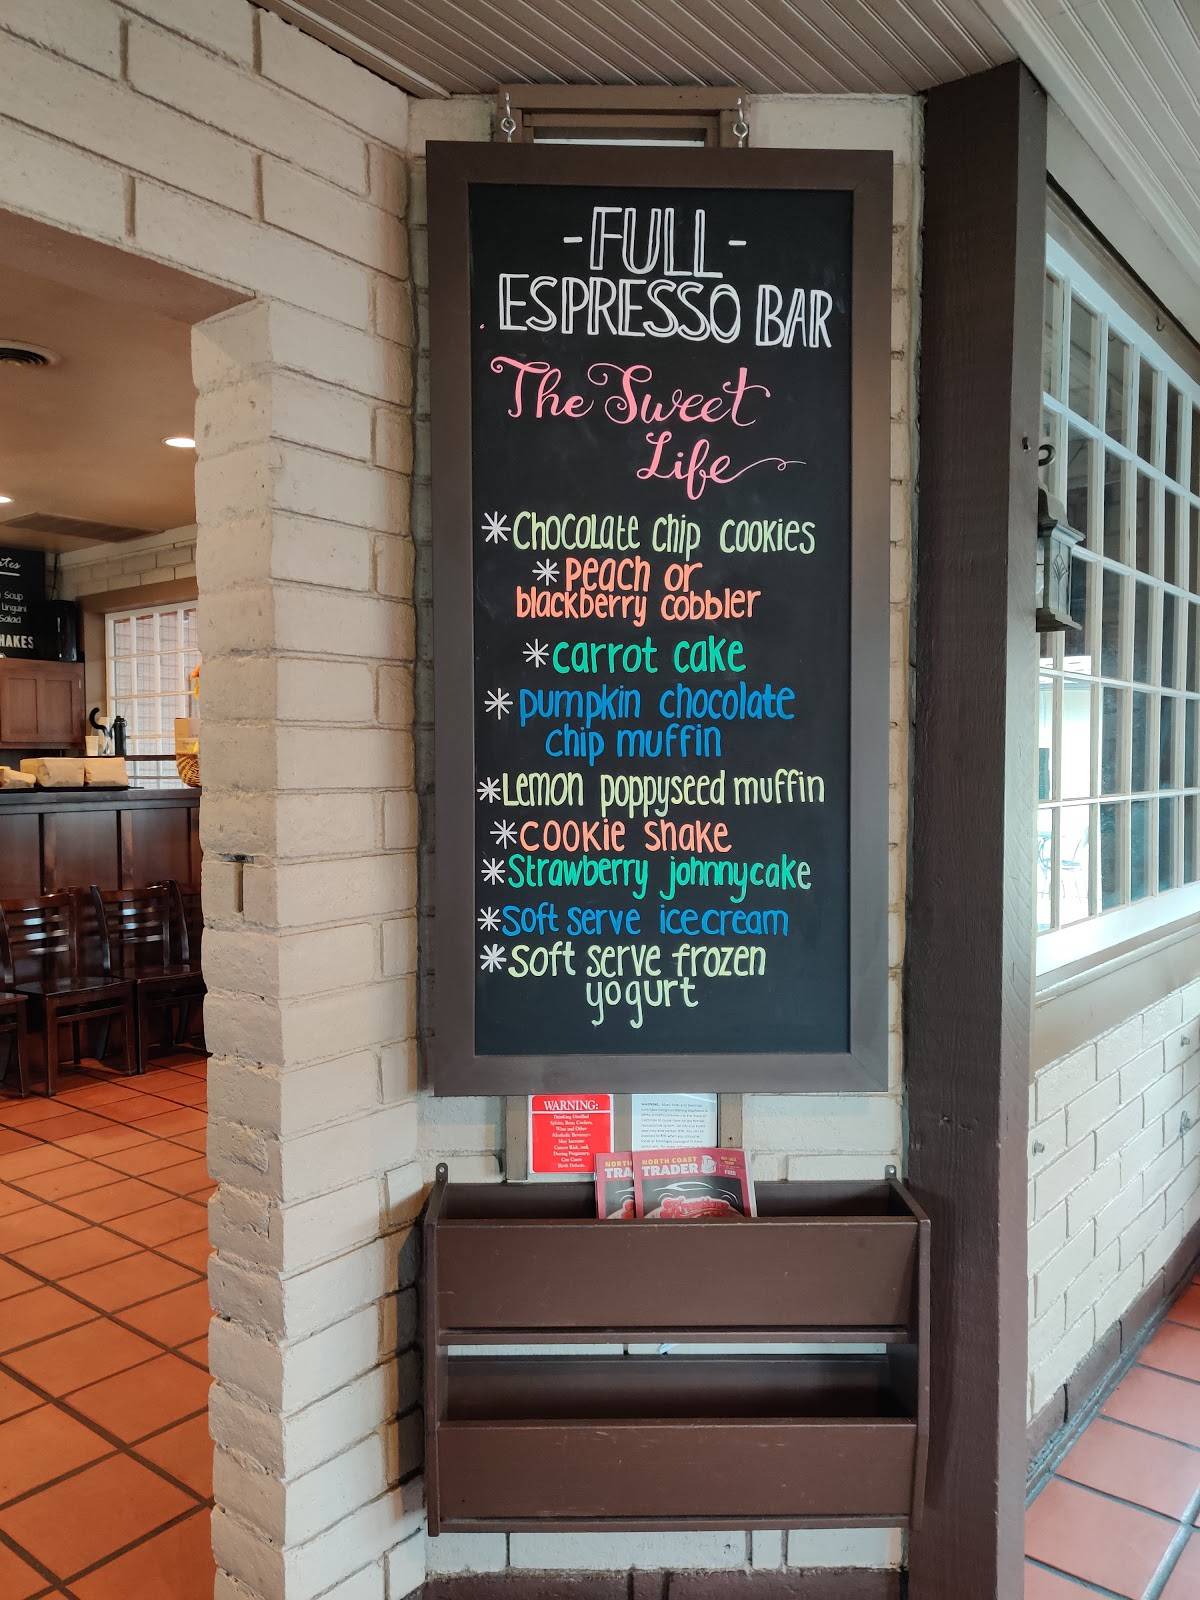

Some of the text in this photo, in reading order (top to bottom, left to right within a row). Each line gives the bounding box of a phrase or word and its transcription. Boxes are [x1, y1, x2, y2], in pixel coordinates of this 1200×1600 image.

[499, 273, 833, 348] ESPRESSO BAR
[490, 355, 771, 427] The Sweet
[636, 430, 807, 501] Life
[663, 561, 704, 593] or
[515, 585, 762, 628] blackberry cobbler
[552, 635, 747, 674] carrot cake
[518, 680, 796, 728] pumpkin chocolate
[545, 722, 722, 767] chip muffin
[502, 768, 826, 818] Lemon poppyseed muffin
[507, 852, 812, 904] Strawberry johnnycake
[566, 904, 642, 937] serve
[585, 944, 662, 978] serve
[671, 942, 767, 978] frozen
[585, 976, 699, 1029] yogurt
[543, 1100, 599, 1111] WARNING:
[641, 1156, 698, 1166] NORTH COAST
[641, 1163, 699, 1177] TRADER
